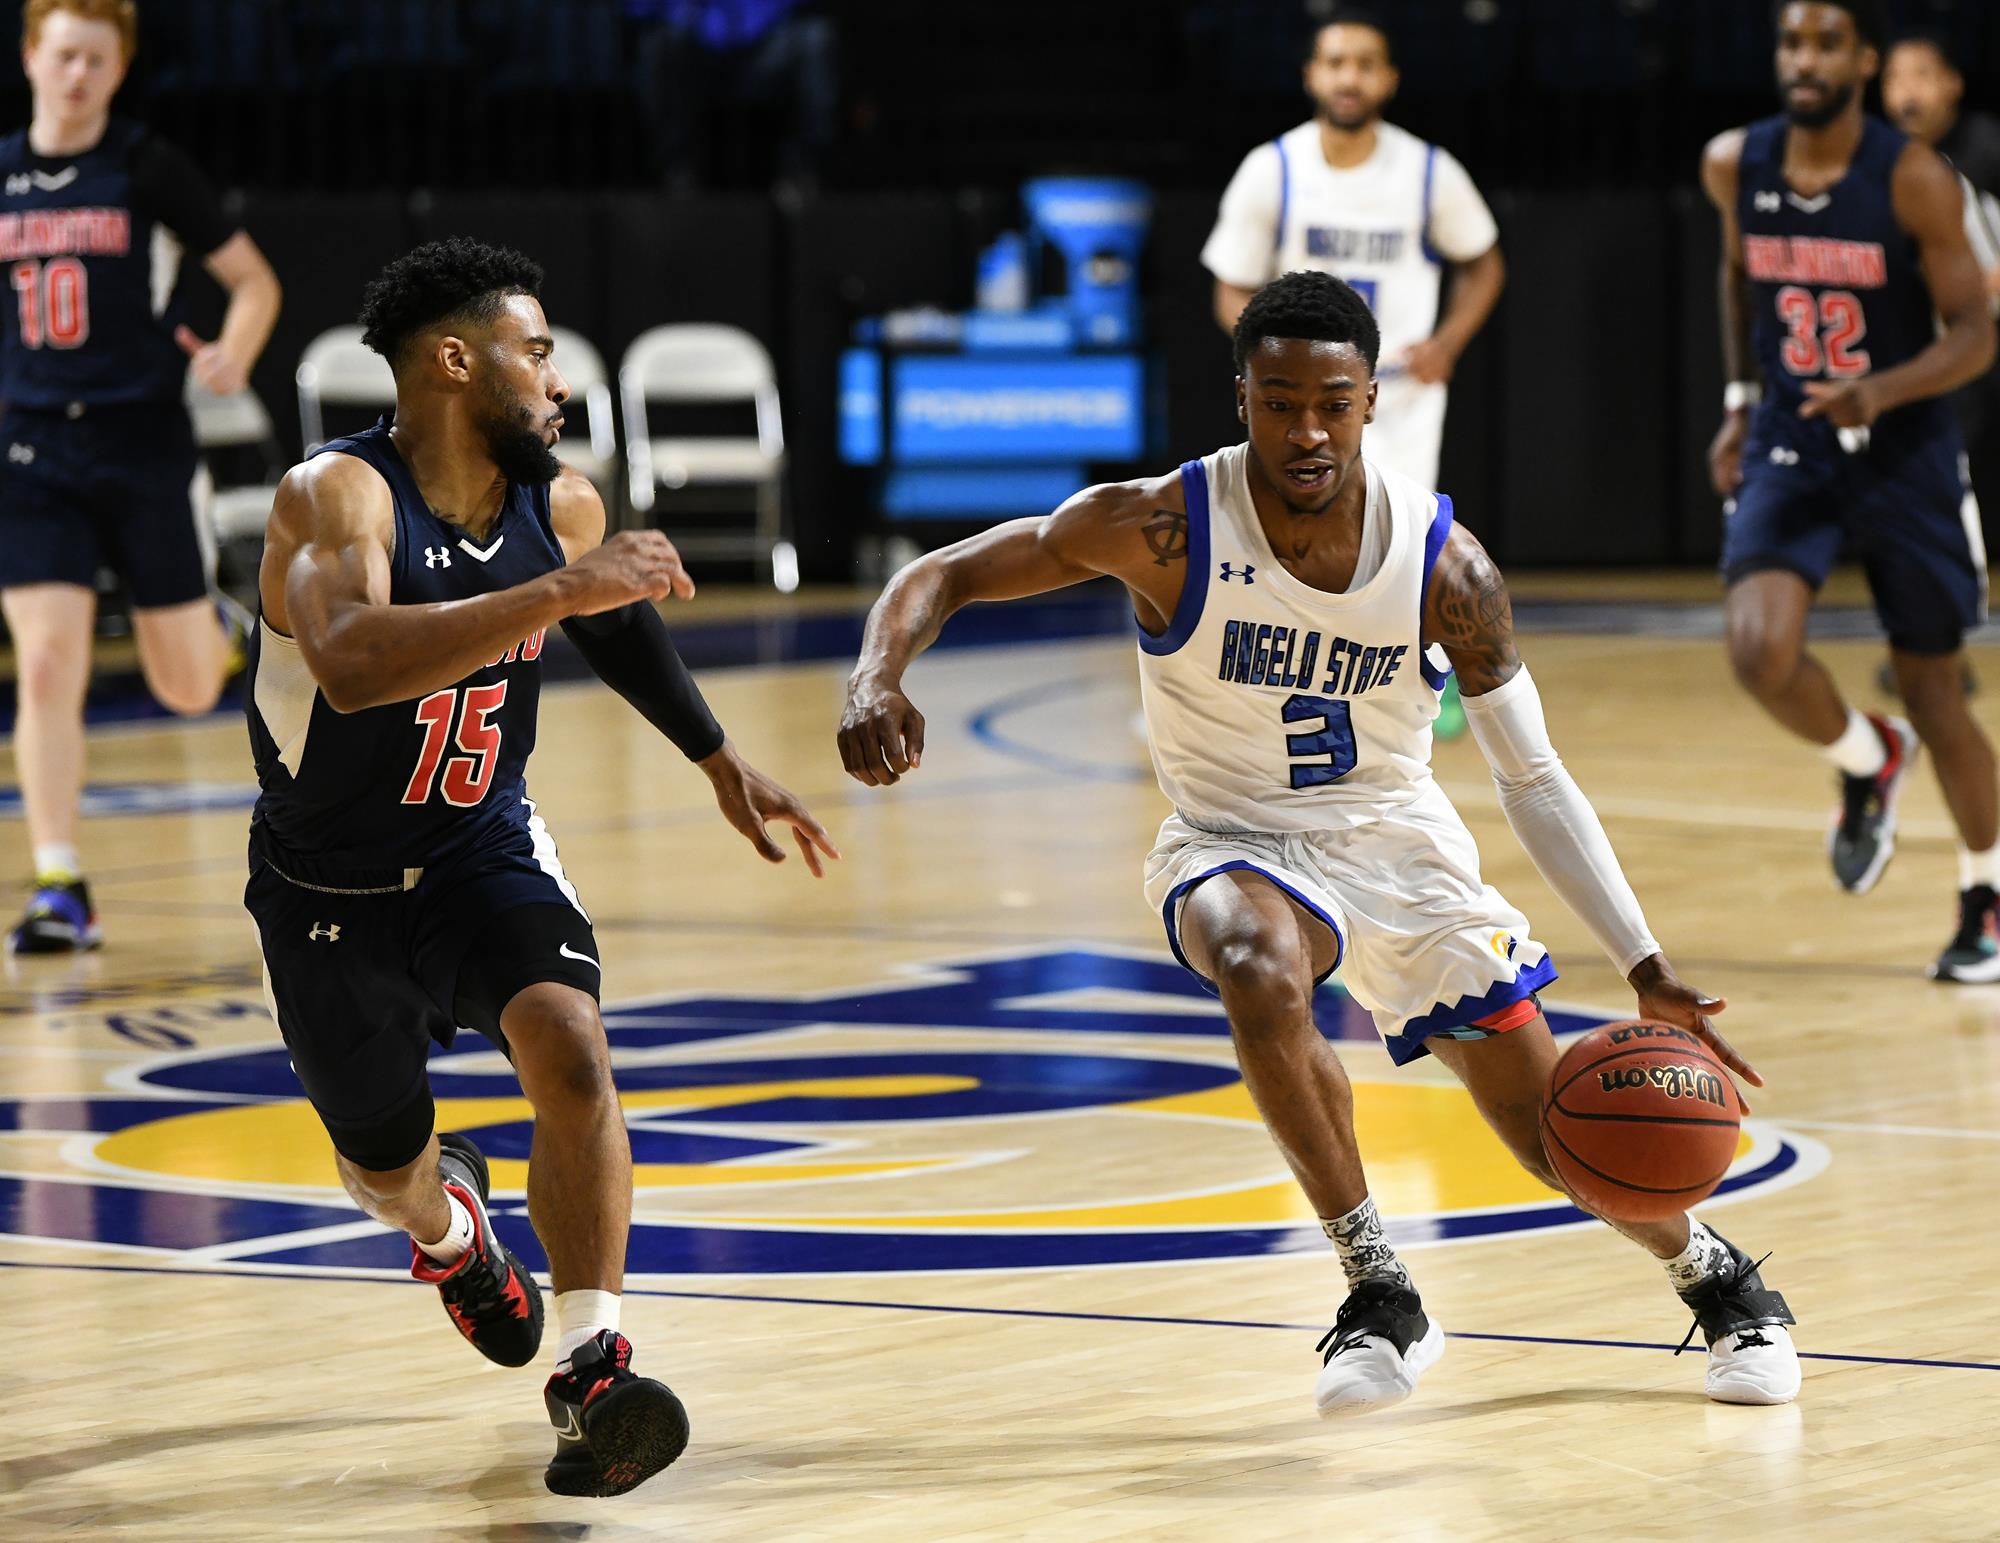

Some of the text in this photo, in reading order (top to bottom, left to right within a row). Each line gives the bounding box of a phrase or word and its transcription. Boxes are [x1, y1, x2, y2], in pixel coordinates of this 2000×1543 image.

[11, 257, 88, 349] 10
[1775, 286, 1871, 379] 32
[1219, 619, 1409, 696] ANGELO STATE
[400, 679, 508, 808] 15
[1281, 693, 1358, 790] 3
[1600, 1066, 1726, 1109] Wilson
